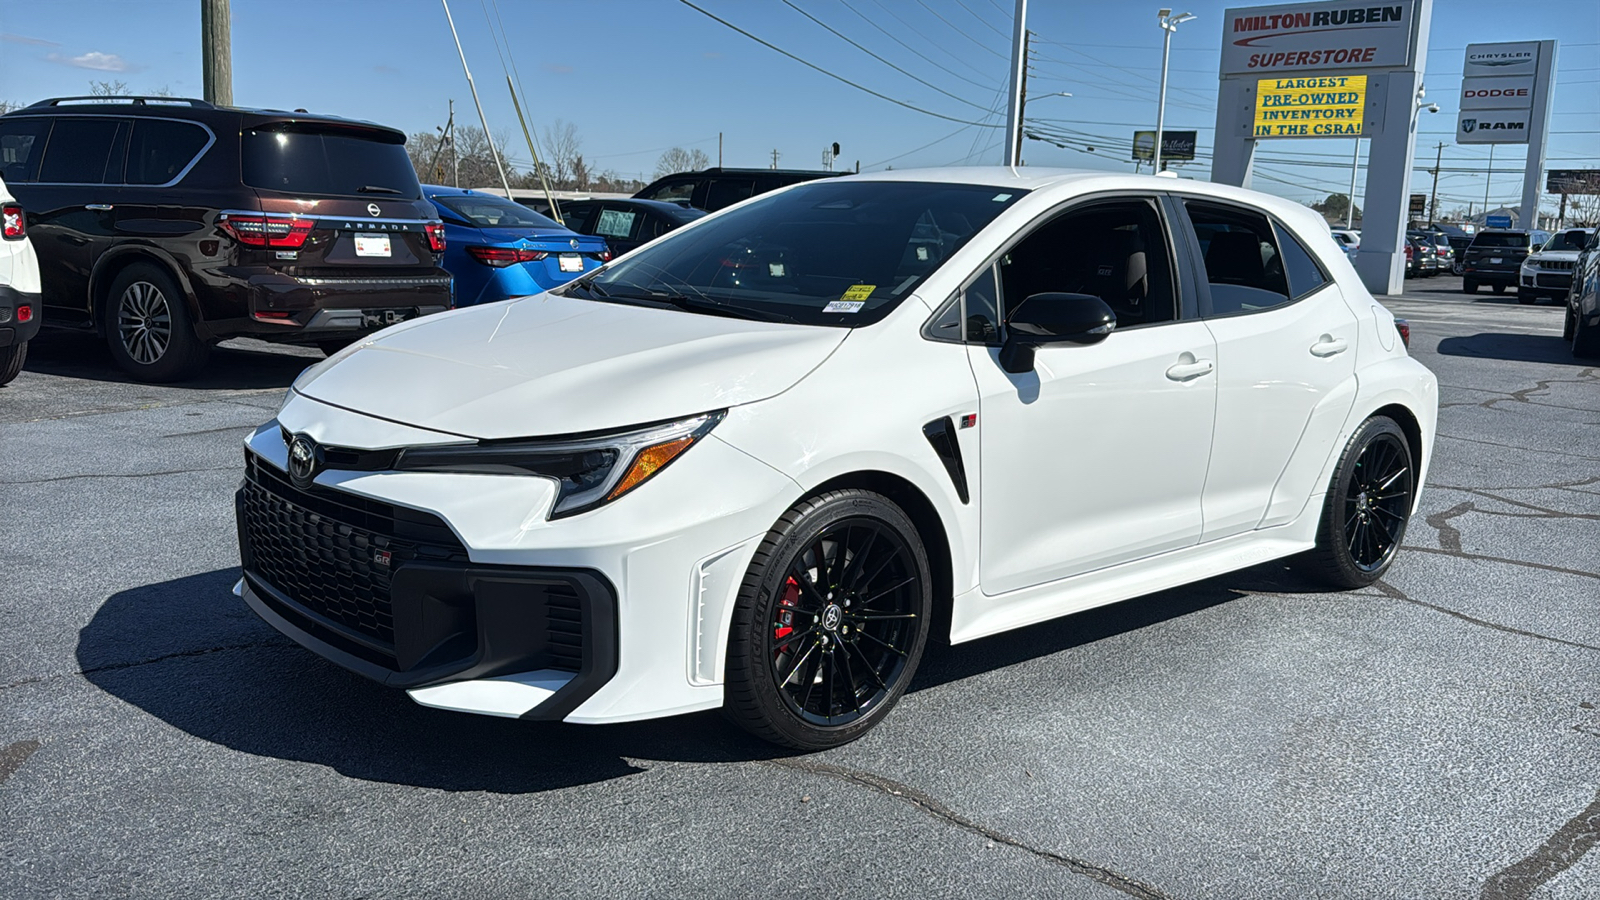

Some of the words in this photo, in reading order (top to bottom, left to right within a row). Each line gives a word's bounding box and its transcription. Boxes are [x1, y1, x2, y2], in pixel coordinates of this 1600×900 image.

[1233, 12, 1311, 32] MILTON
[1312, 6, 1402, 26] RUBEN
[1247, 47, 1377, 68] SUPERSTORE
[1469, 52, 1531, 60] CHRYSLER
[1275, 77, 1348, 89] LARGEST
[1262, 92, 1359, 106] PRE-OWNED
[1464, 88, 1528, 98] DODGE
[1263, 108, 1356, 120] INVENTORY
[1255, 125, 1272, 136] IN
[1277, 124, 1308, 135] THE
[1313, 123, 1361, 135] CSRA!
[1478, 122, 1524, 130] RAM
[344, 222, 408, 231] ARMADA
[375, 554, 390, 565] GR
[752, 590, 769, 679] MICHELIN
